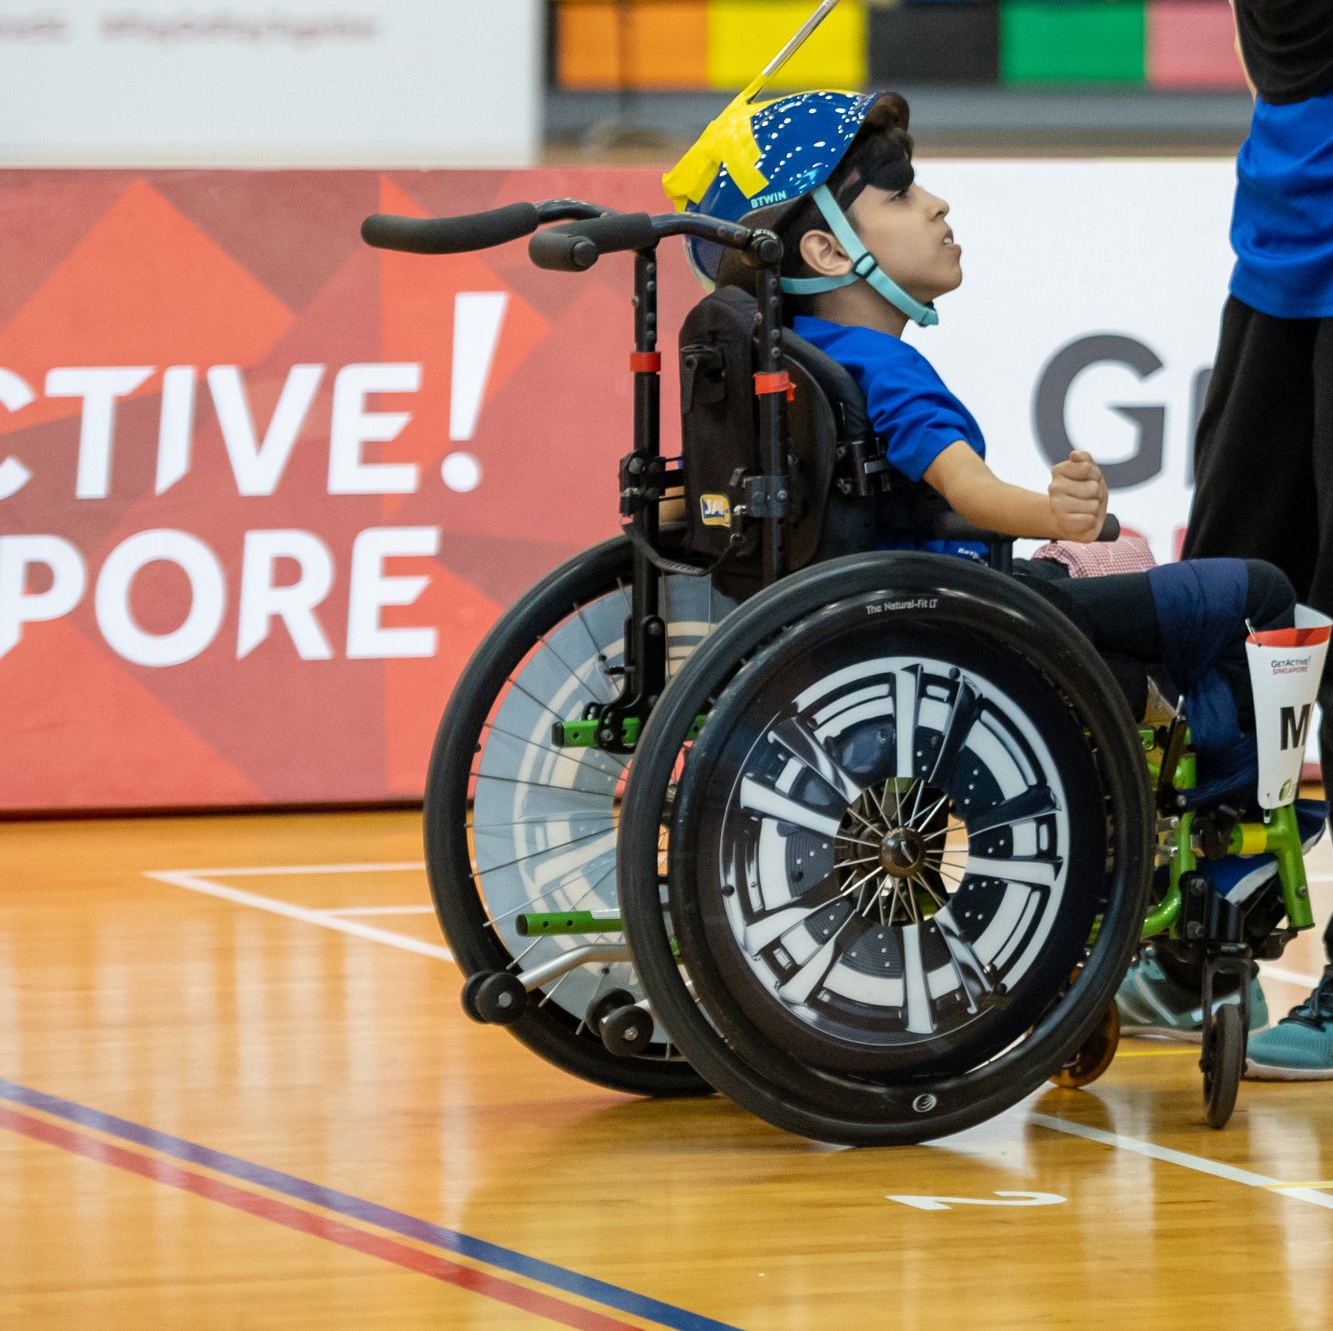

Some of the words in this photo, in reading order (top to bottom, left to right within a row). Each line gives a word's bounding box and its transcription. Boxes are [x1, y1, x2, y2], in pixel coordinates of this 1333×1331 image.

[750, 190, 787, 209] BTWIN
[0, 526, 440, 667] PORE
[866, 605, 881, 615] The
[884, 598, 928, 611] Natural-Fit
[1272, 666, 1308, 675] SINGAPORE
